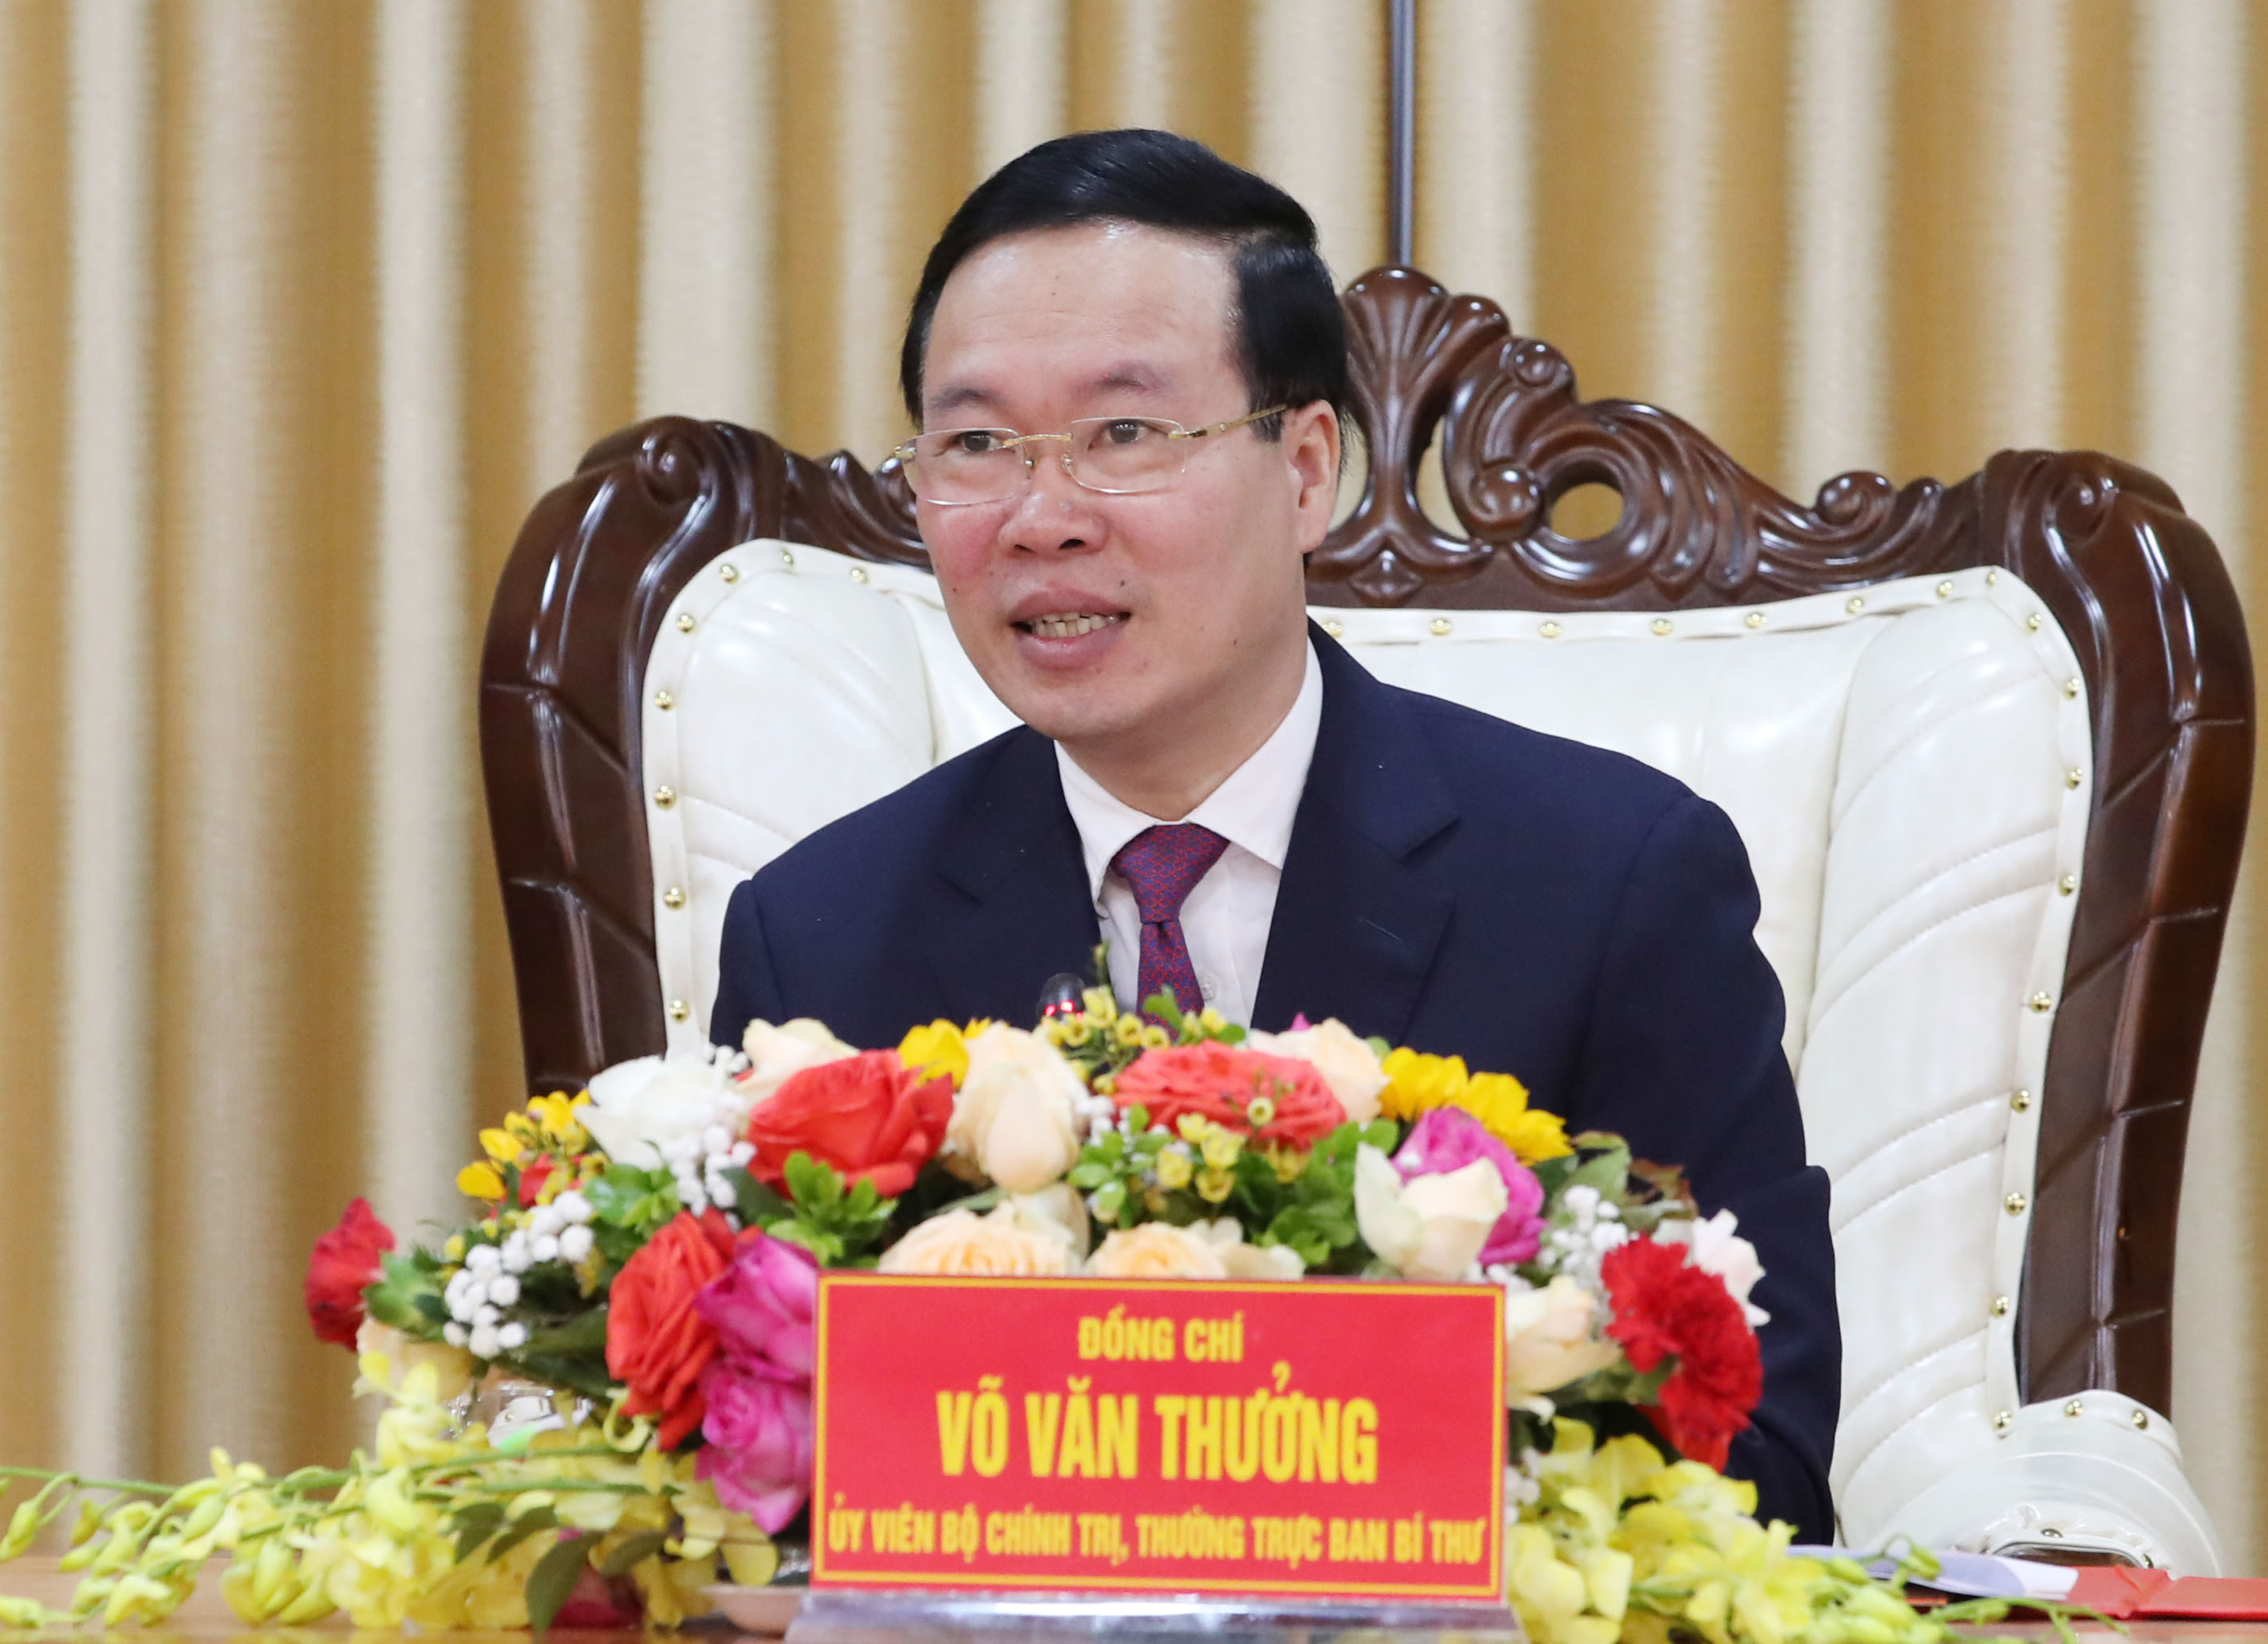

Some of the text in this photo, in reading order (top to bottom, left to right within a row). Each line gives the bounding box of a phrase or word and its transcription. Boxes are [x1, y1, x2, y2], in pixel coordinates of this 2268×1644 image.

[1184, 1310, 1244, 1362] CHÍ
[937, 1362, 1378, 1484] VÕ VĂN THƯỞNG
[829, 1494, 866, 1554] ỦY
[870, 1502, 937, 1554] VIÊN
[941, 1503, 981, 1563] BỘ
[986, 1503, 1073, 1556] CHÍNH
[1077, 1514, 1130, 1566] TRỊ,
[1251, 1514, 1324, 1569] TRỰC
[1329, 1518, 1389, 1562] BAN
[1394, 1511, 1424, 1563] BÍ
[1429, 1517, 1487, 1565] THƯ
